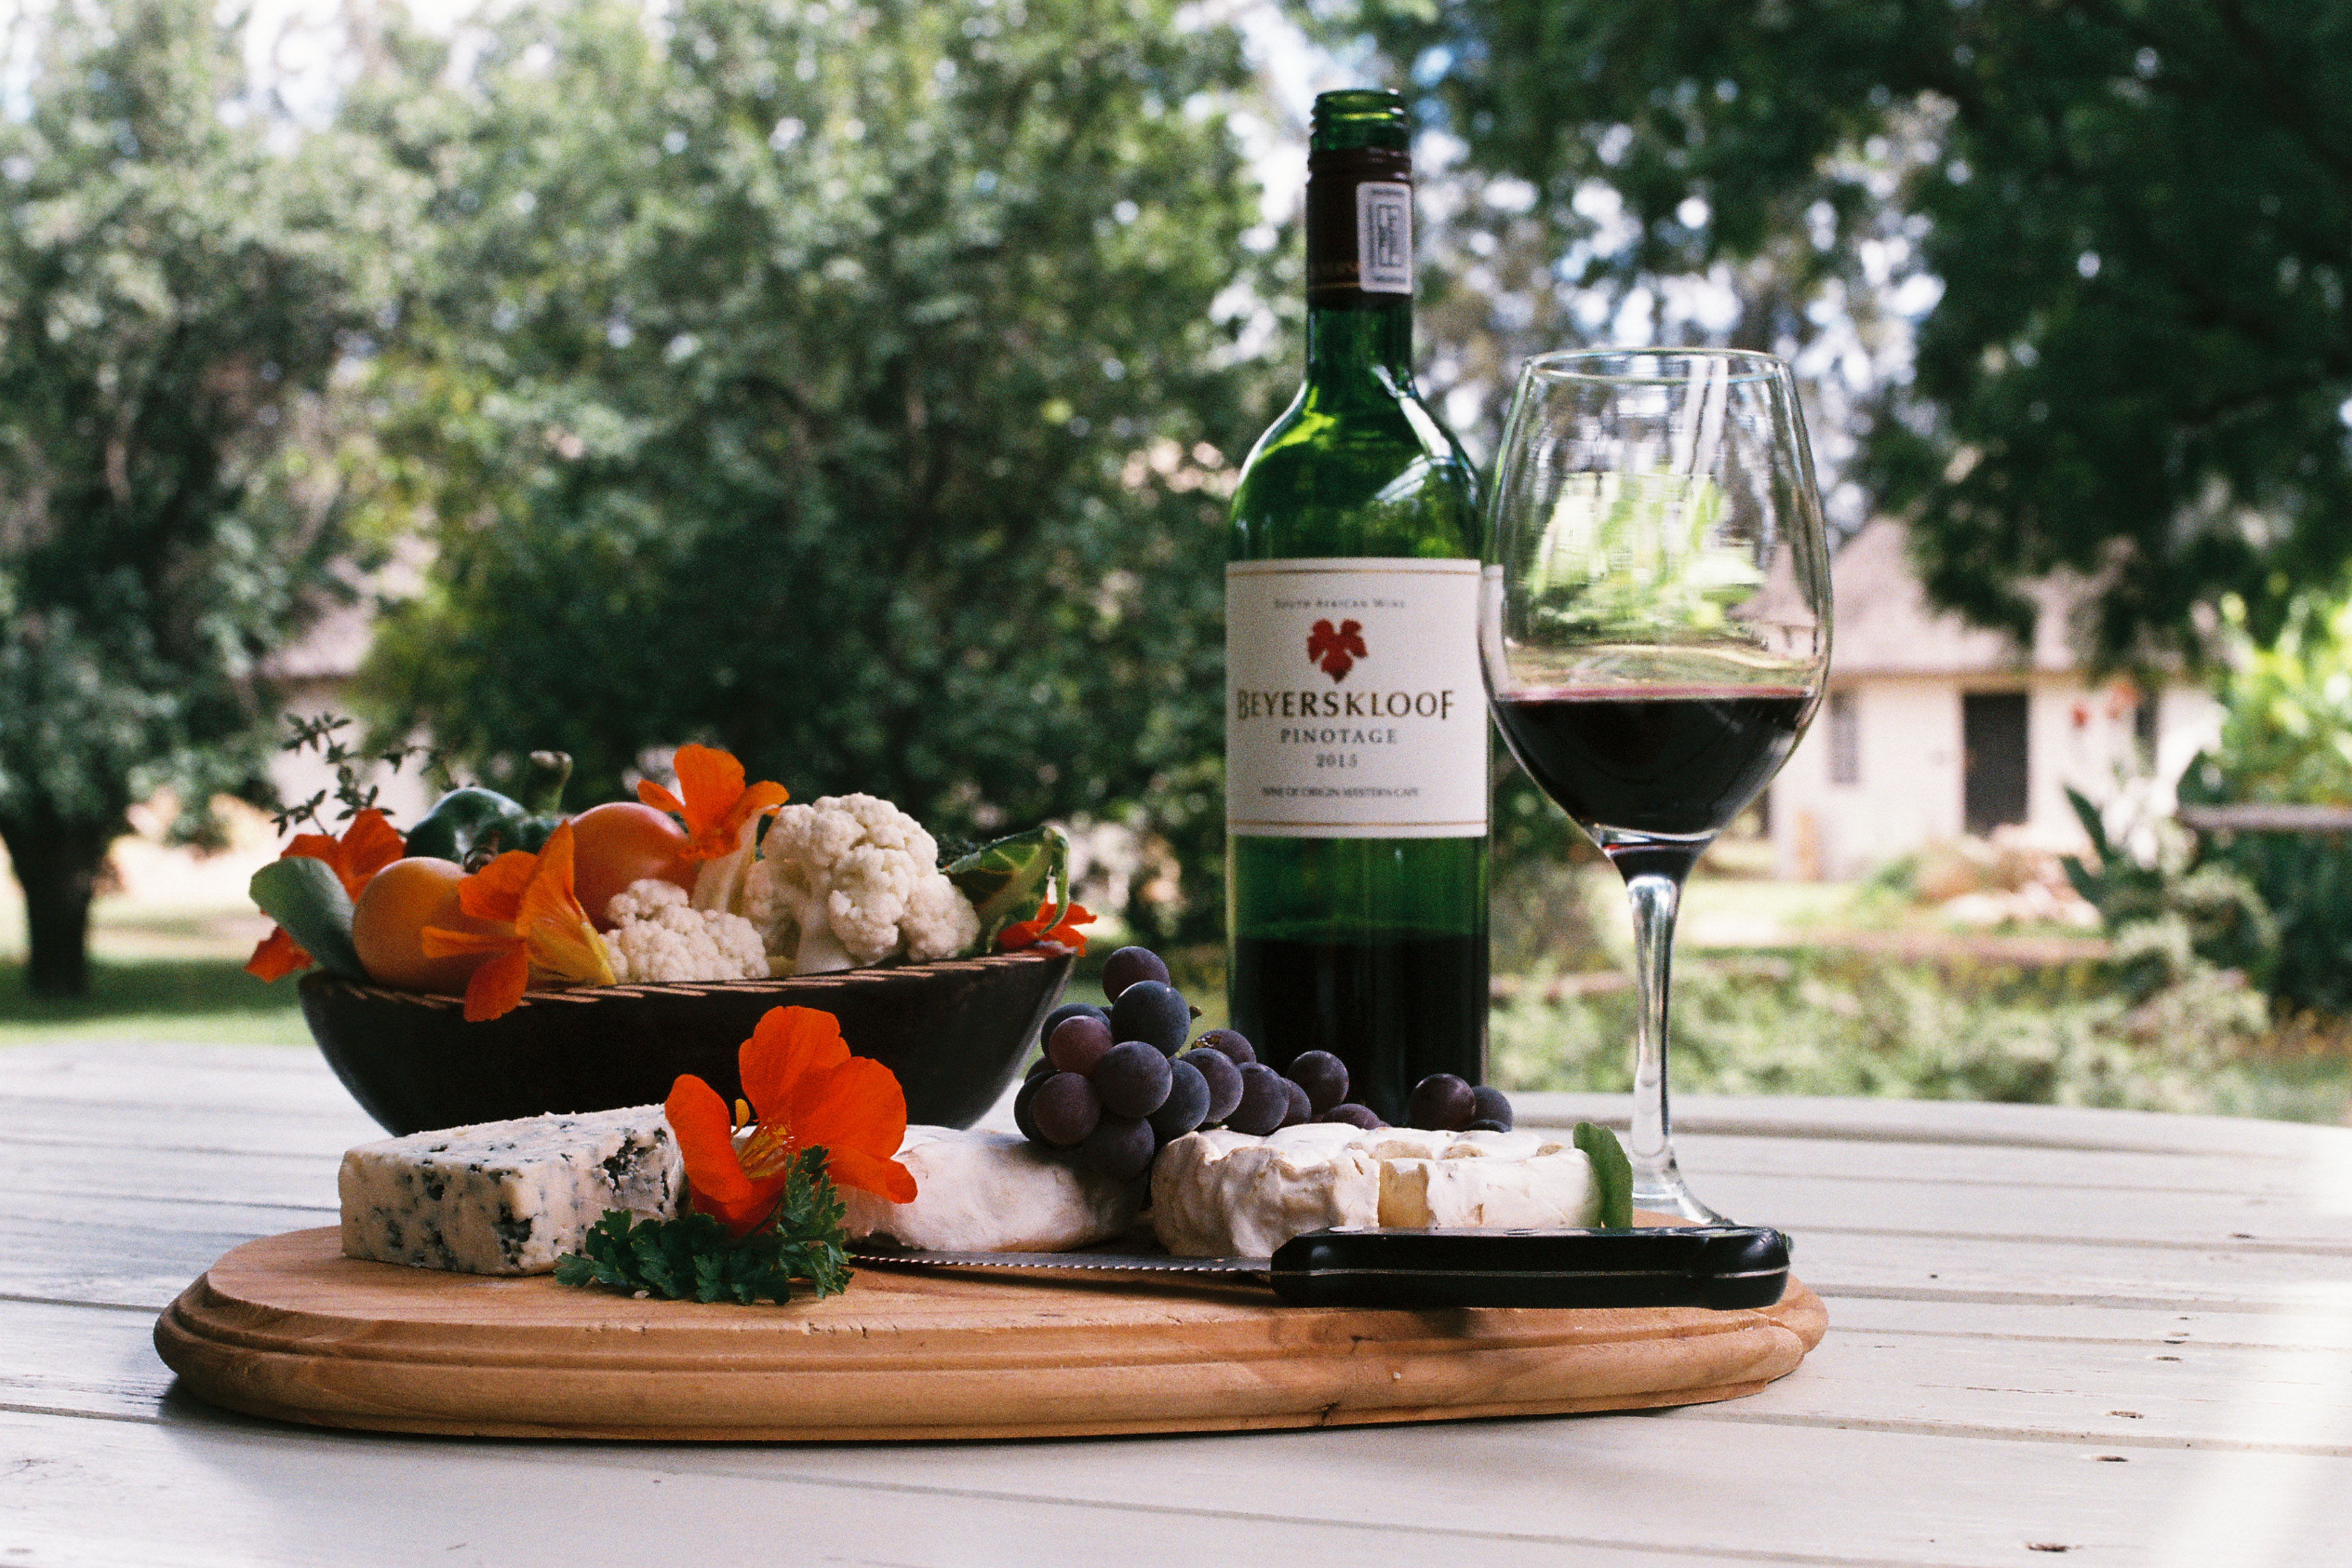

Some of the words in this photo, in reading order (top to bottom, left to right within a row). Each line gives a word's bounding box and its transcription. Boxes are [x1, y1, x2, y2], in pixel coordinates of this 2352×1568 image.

[1237, 689, 1454, 721] BEYERSKLOOF
[1280, 728, 1397, 744] PINOTAGE
[1316, 753, 1358, 768] 2015
